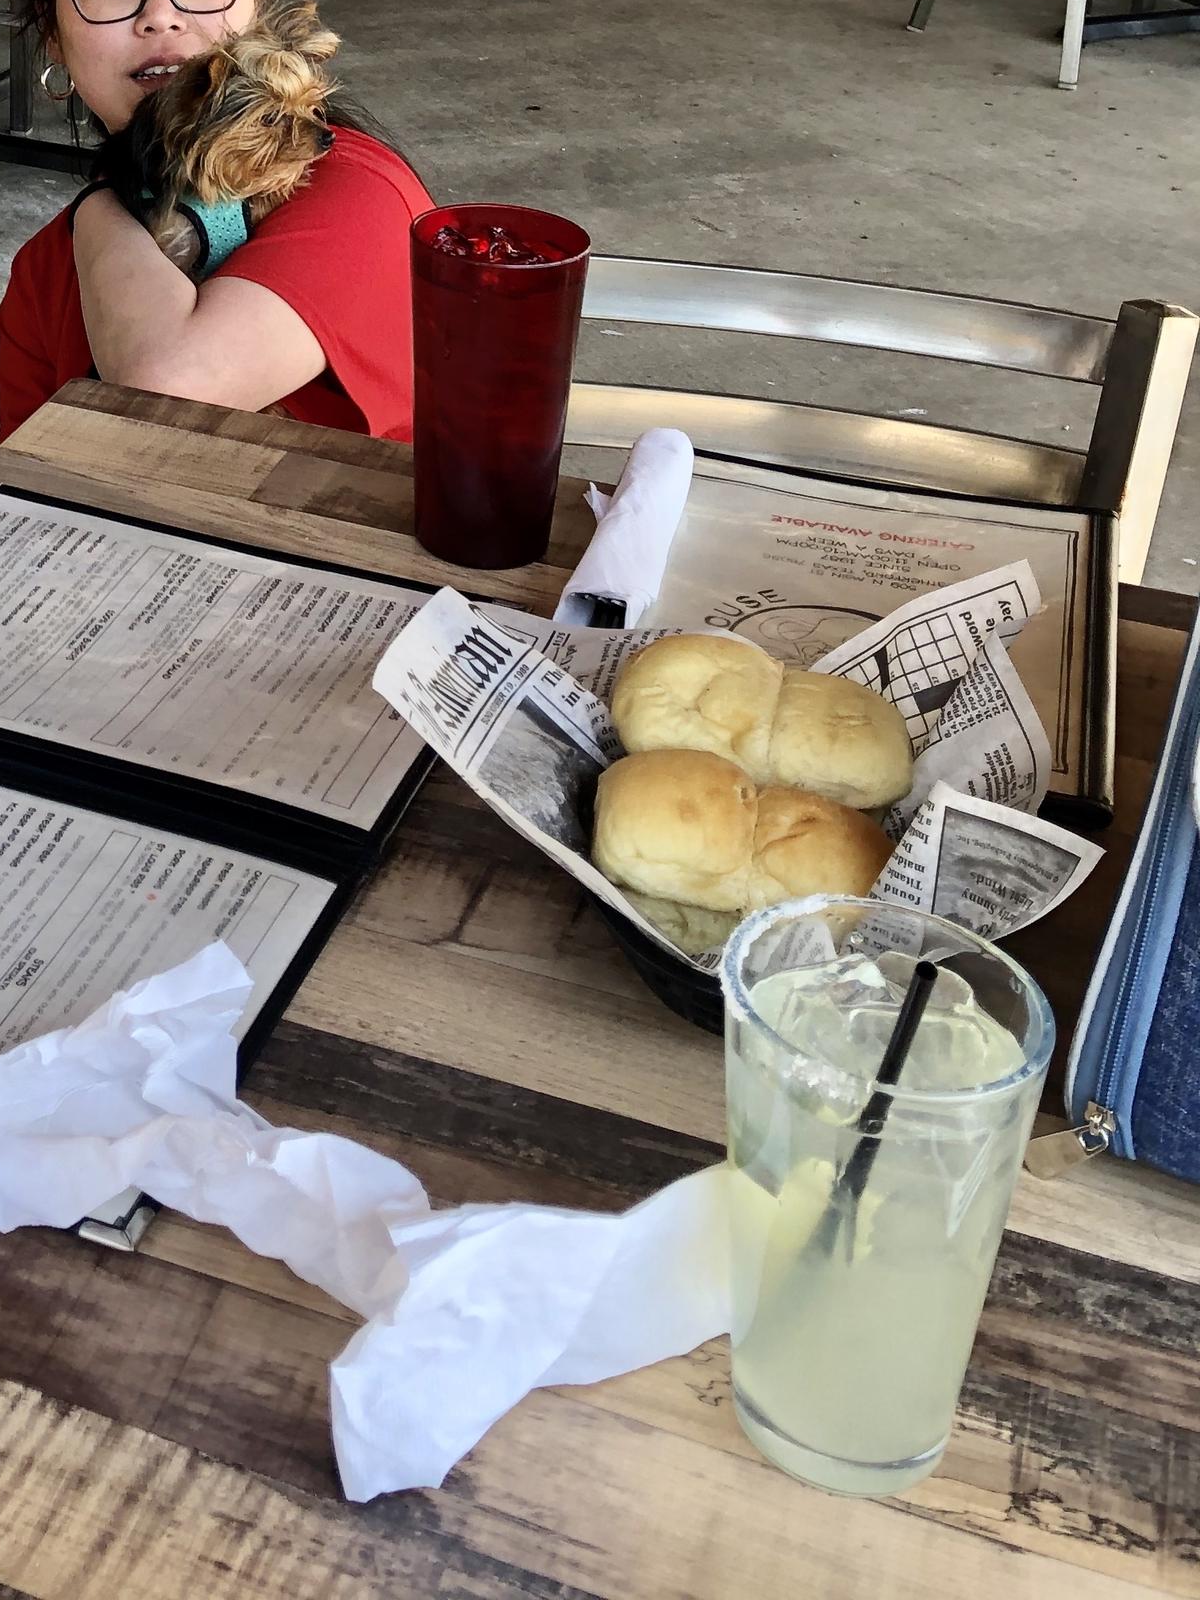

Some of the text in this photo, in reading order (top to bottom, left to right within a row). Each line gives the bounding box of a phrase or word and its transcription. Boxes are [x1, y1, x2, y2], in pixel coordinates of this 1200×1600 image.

[771, 515, 975, 551] CATERING AVAILABLE
[807, 536, 848, 547] WEEK
[821, 554, 911, 572] SINCE 1987
[875, 548, 915, 558] DAYS
[813, 562, 854, 574] TEXAS
[918, 560, 961, 572] OPEN
[863, 570, 945, 587] ATHERFORD,
[704, 588, 787, 628] OUSE
[562, 691, 582, 707] in
[15, 806, 38, 827] STEAK
[5, 828, 23, 842] AND
[6, 812, 57, 868] STEAK TRIMMINGS
[34, 817, 77, 863] DINNER STEAK
[886, 868, 923, 891] Titanic
[969, 871, 1007, 897] Winds
[883, 884, 921, 906] found
[961, 887, 996, 916] Sunny
[14, 957, 45, 988] STEAKS
